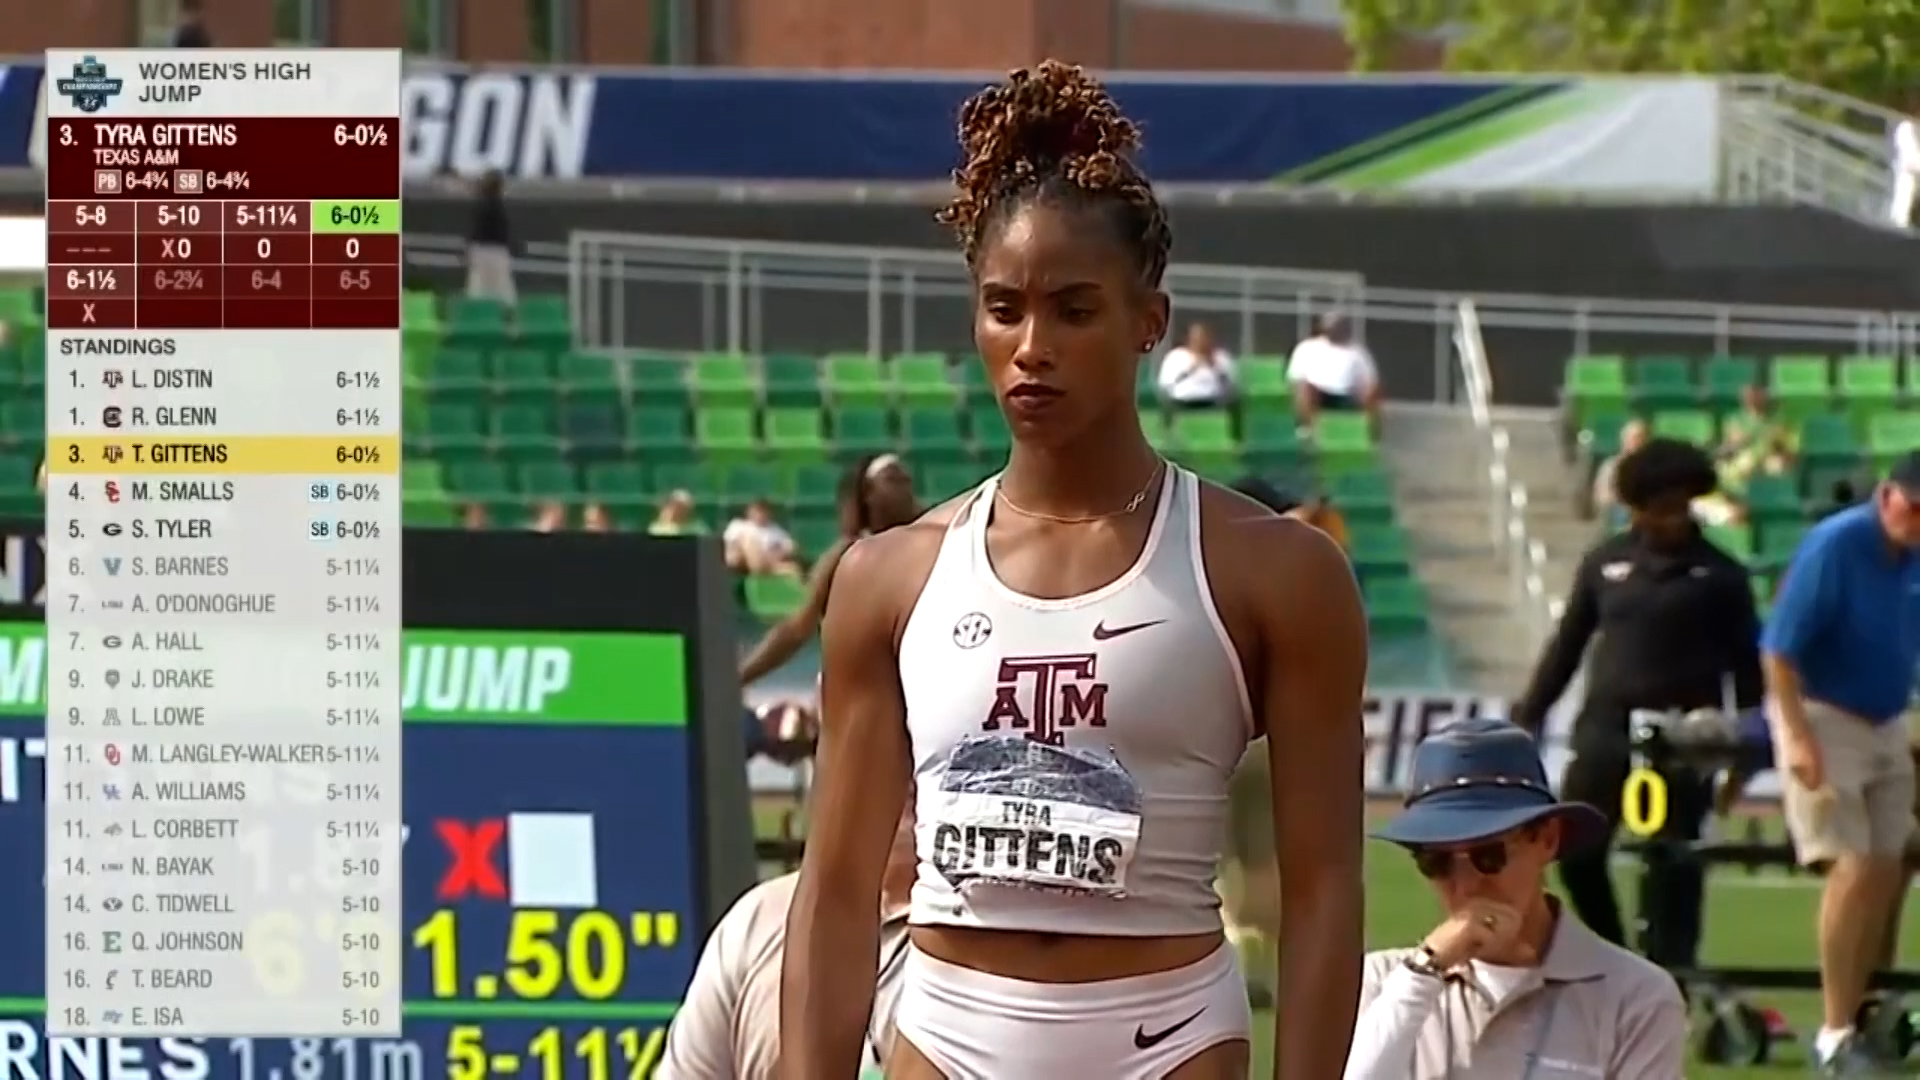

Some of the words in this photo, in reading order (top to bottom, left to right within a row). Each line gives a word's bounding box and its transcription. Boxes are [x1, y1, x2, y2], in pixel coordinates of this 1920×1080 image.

[401, 645, 571, 713] JUMP
[1002, 800, 1052, 826] TYRA
[1622, 767, 1668, 836] 0
[434, 817, 509, 901] X
[932, 823, 1122, 885] GITTENS
